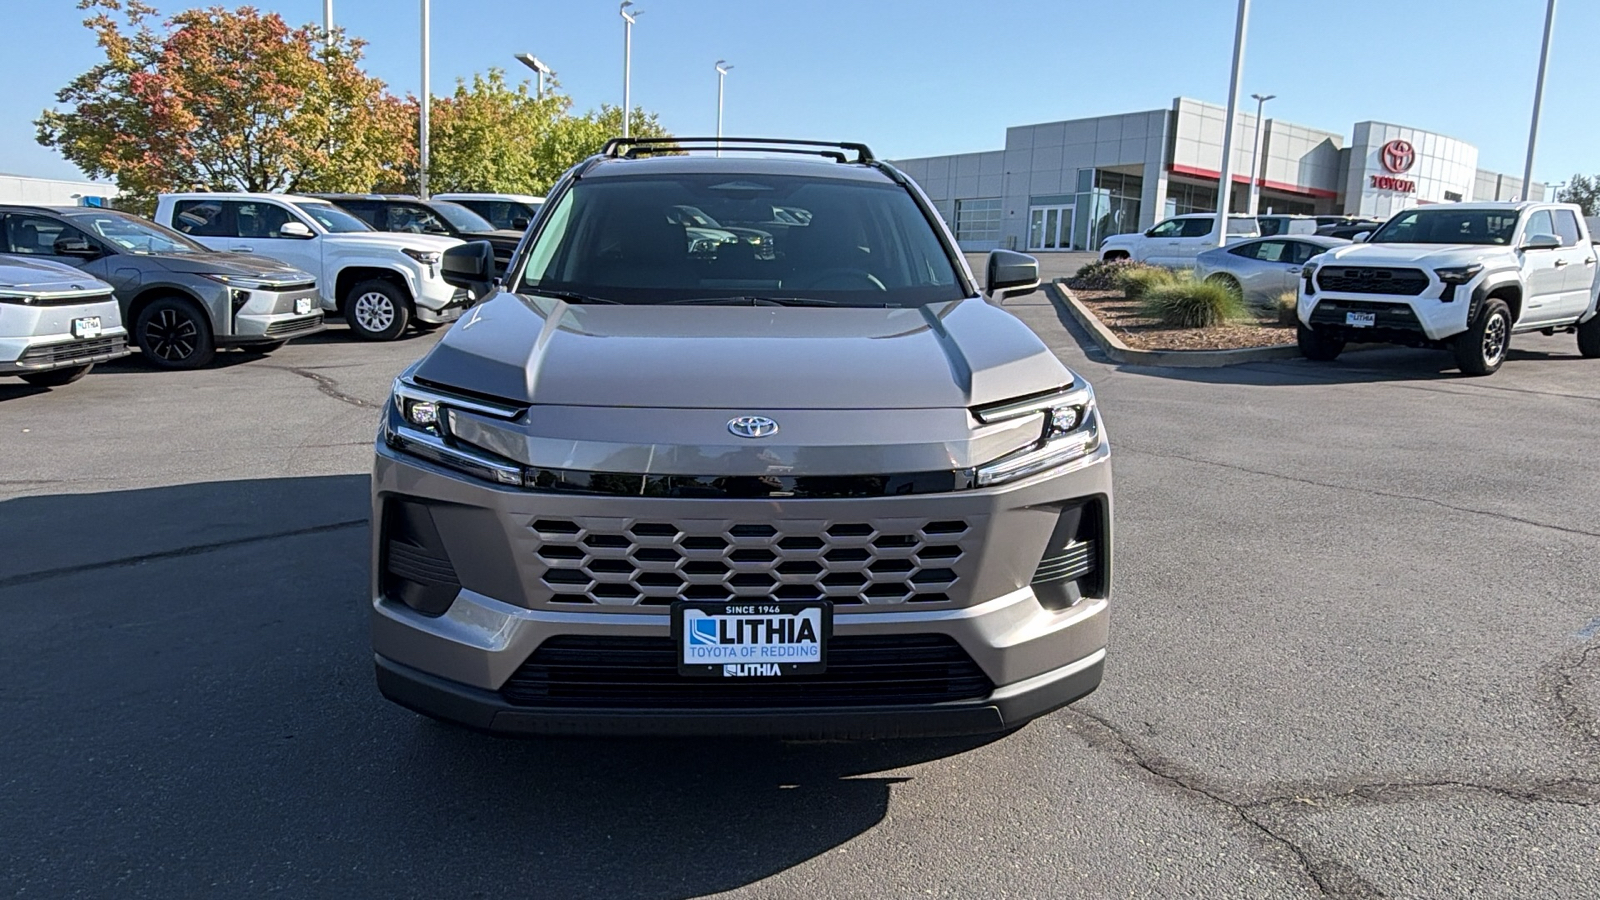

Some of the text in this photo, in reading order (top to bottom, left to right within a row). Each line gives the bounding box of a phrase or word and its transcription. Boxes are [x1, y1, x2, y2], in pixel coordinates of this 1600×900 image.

[1370, 175, 1416, 193] TOYOTA
[725, 605, 780, 614] SINCE 1946
[719, 618, 817, 645] LITHIA
[689, 645, 818, 658] TOYOTA OF REDDING
[736, 663, 782, 677] LITHIA
